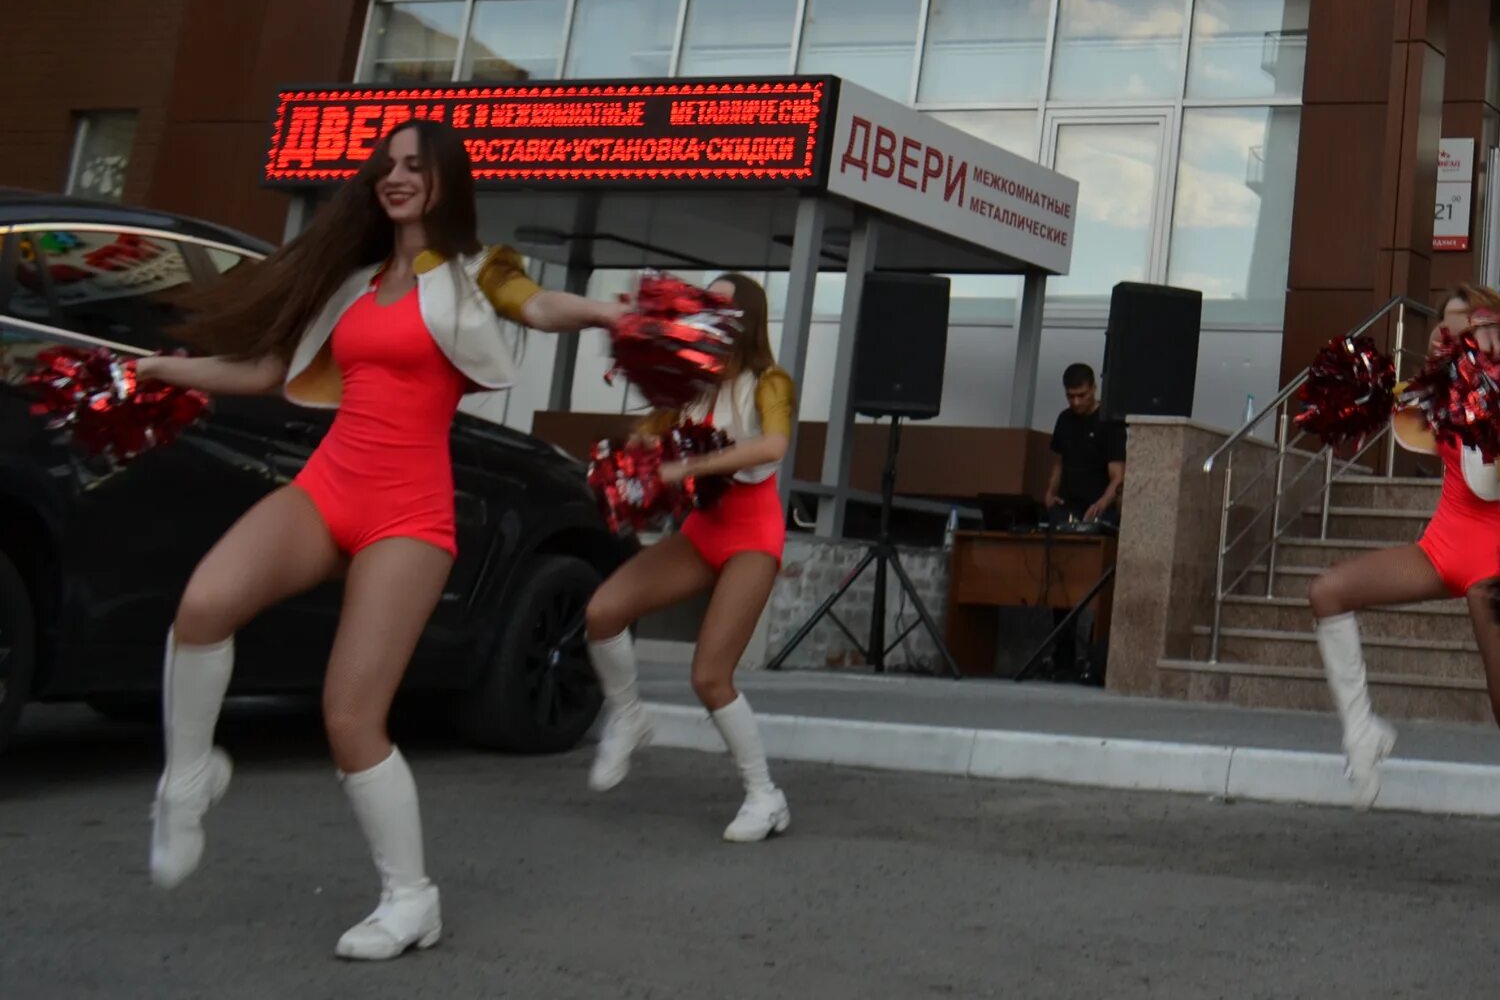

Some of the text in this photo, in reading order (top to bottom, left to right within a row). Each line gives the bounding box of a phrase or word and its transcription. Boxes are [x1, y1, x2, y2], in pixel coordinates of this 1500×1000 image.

[840, 115, 969, 209] ДВЕРИ
[972, 166, 1072, 220] МЕЖКОМНАТНЫЕ
[969, 196, 1069, 248] МЕТАЛЛИЧЕСКИЕ
